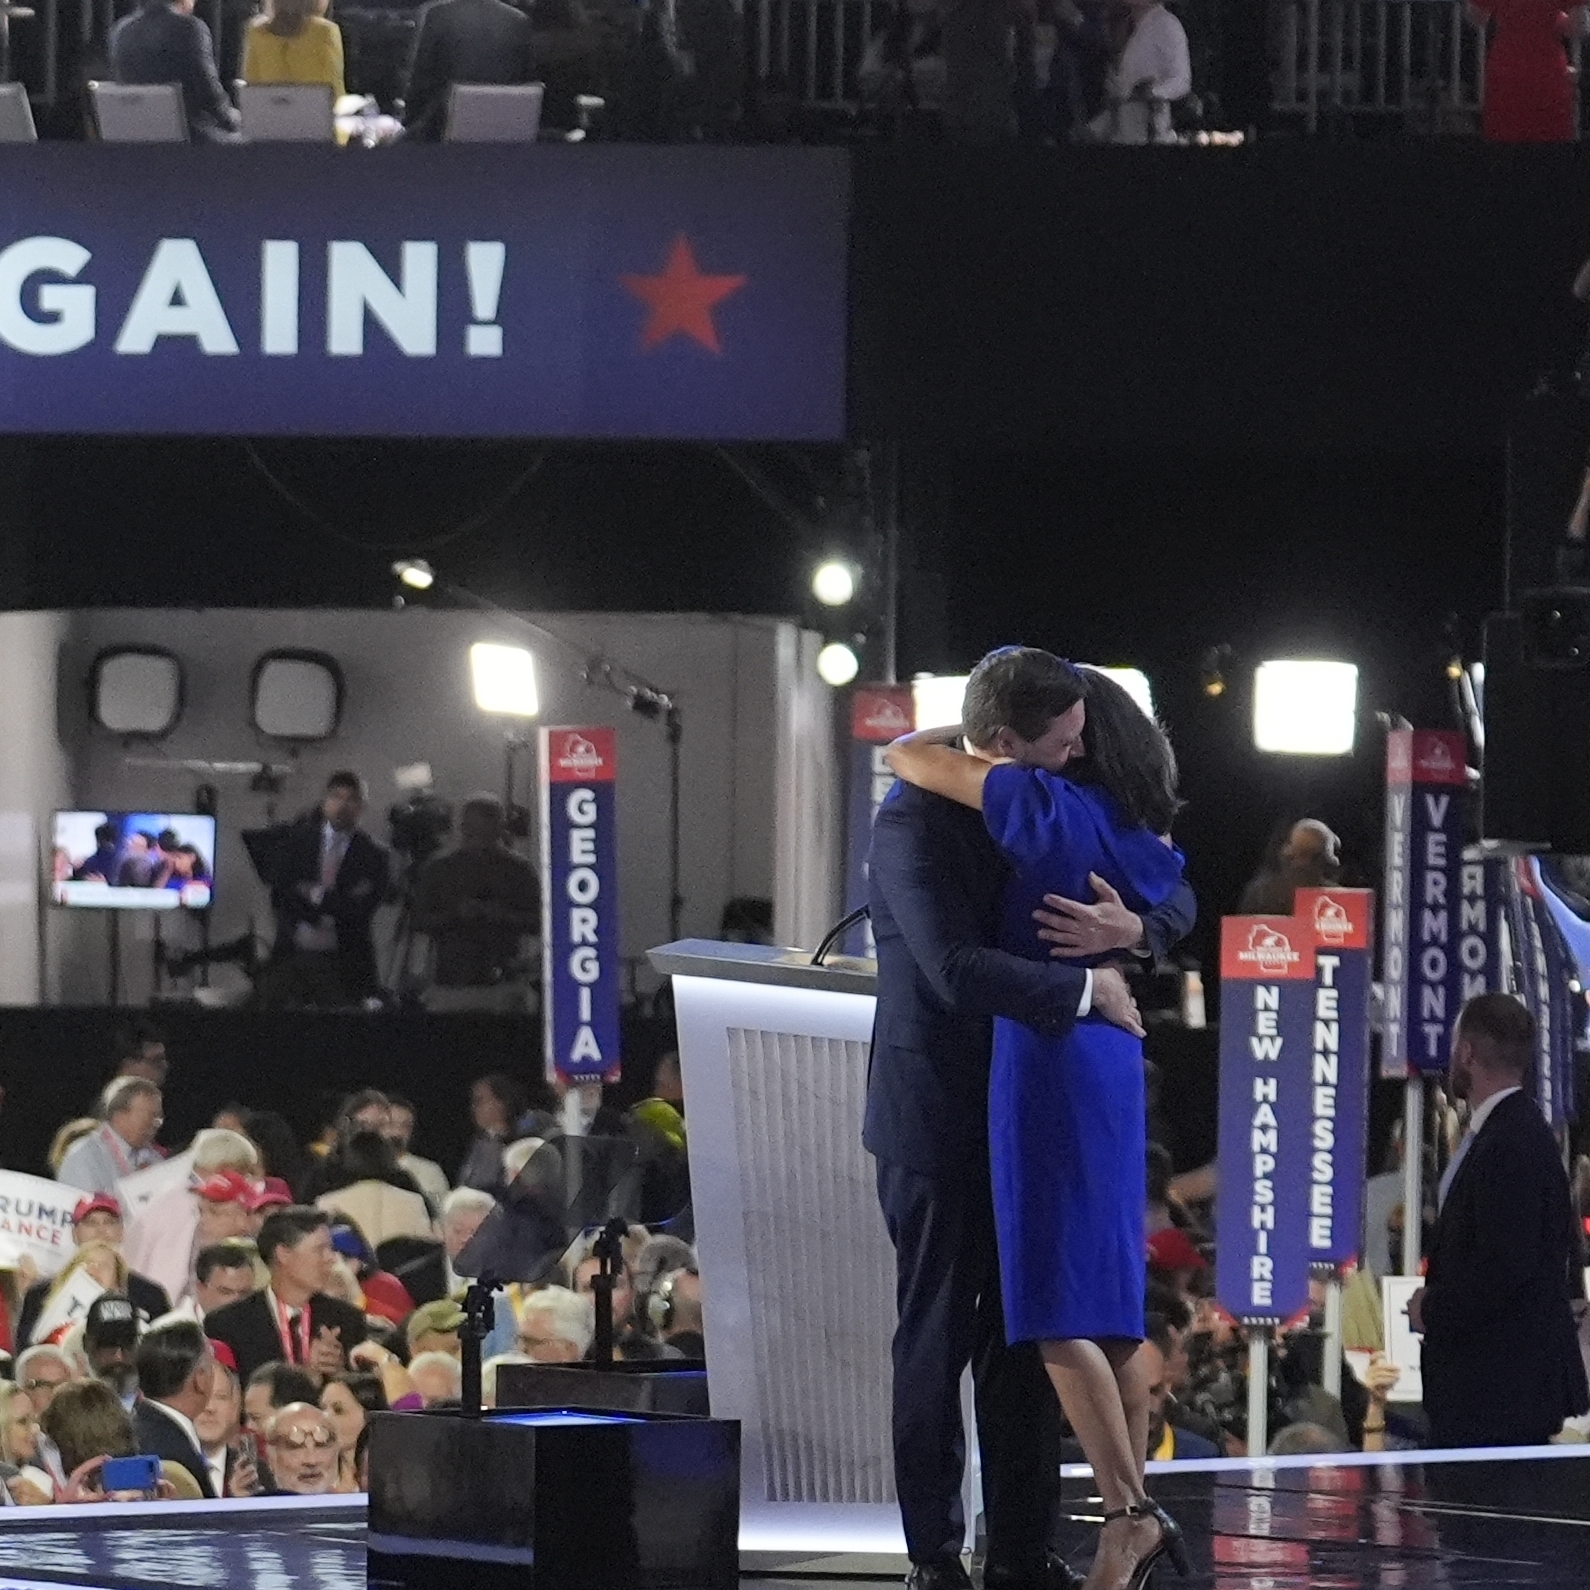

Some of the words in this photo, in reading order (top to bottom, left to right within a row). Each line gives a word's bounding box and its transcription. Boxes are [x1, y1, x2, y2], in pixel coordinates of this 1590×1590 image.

[566, 787, 603, 1063] GEORGIA
[1250, 984, 1283, 1061] NEW
[1388, 796, 1405, 1058] VERMONT
[1423, 794, 1449, 1059] VERMONT
[1250, 1076, 1279, 1307] HAMPSHIRE
[1310, 953, 1341, 1251] TENNESSEE
